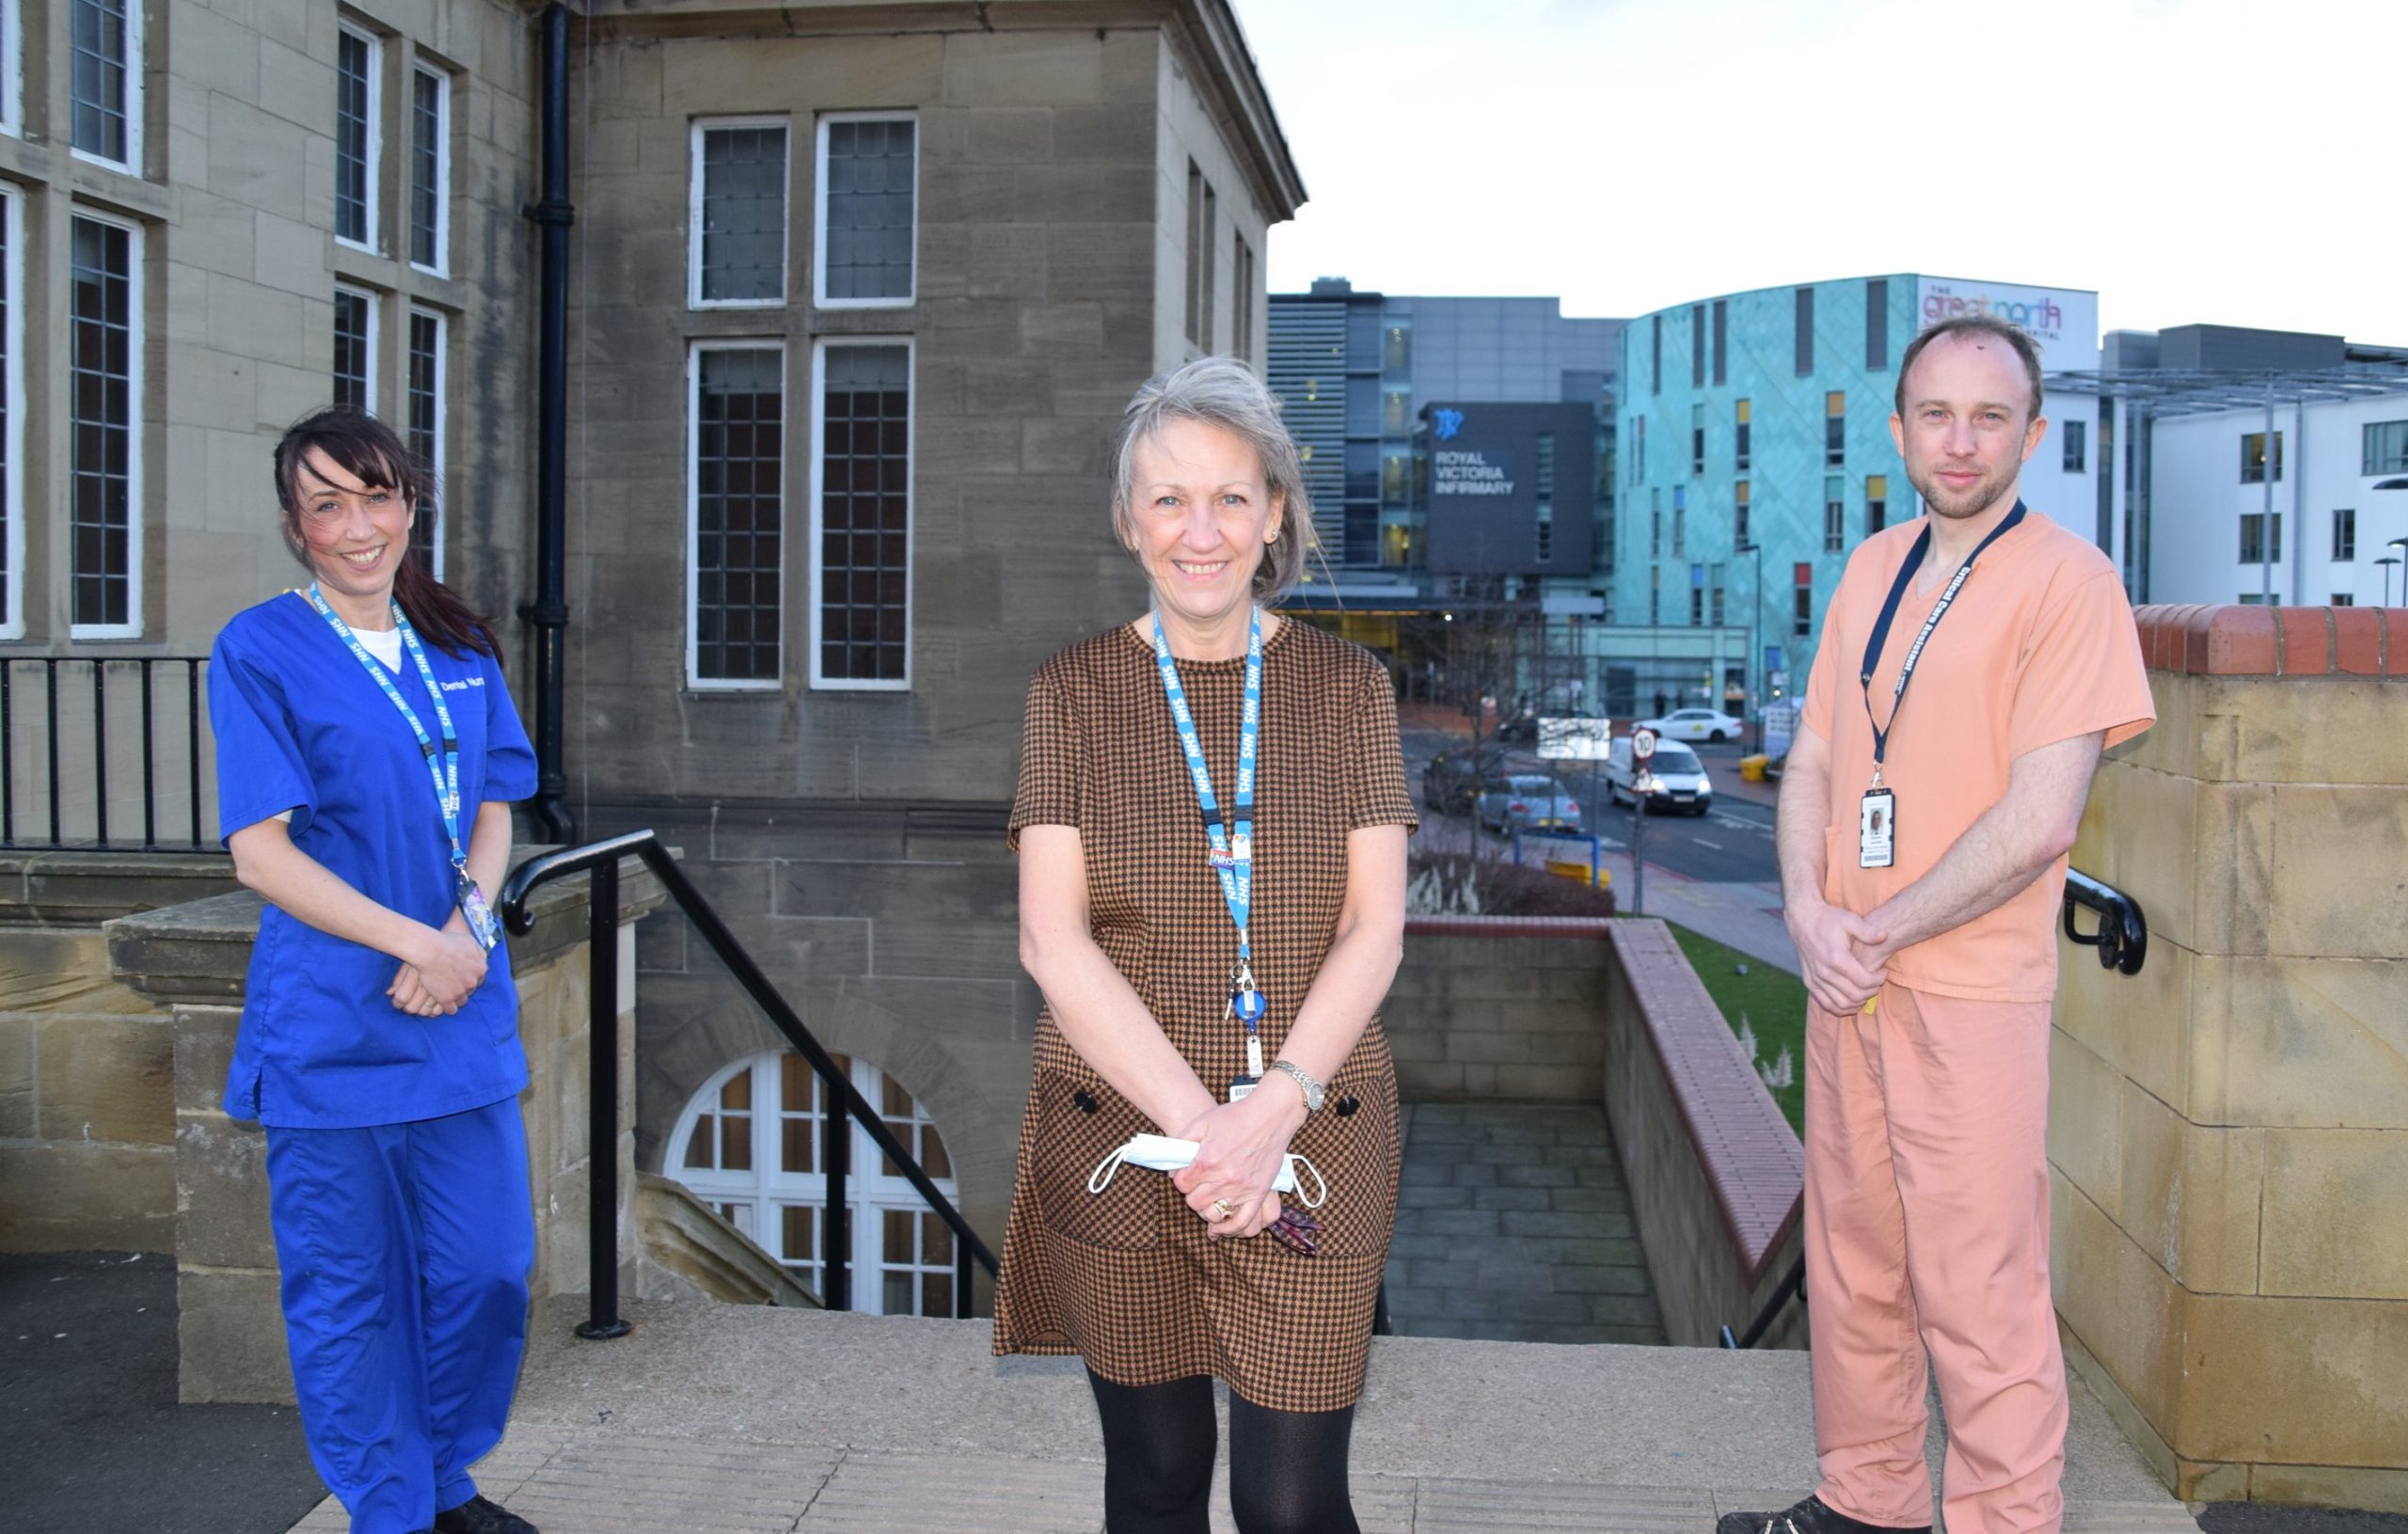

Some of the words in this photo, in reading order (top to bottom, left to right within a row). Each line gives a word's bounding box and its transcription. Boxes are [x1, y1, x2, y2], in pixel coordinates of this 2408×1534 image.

[1994, 296, 2062, 330] north
[1435, 451, 1487, 467] ROYAL
[1435, 467, 1505, 480] VICTORIA
[1435, 481, 1514, 495] INFIRMARY
[314, 595, 330, 615] NHS
[331, 618, 351, 638] NHS
[351, 642, 370, 662] NHS
[1156, 635, 1168, 658] NHS
[1250, 632, 1260, 658] NHS
[370, 667, 389, 687] NHS
[391, 605, 405, 624] NHS
[402, 629, 419, 649] NHS
[414, 654, 431, 674] NHS
[426, 680, 442, 699] NHS
[436, 706, 452, 727] NHS
[1163, 665, 1179, 690] NHS
[1247, 664, 1259, 690] NHS
[441, 682, 468, 691] Dental
[388, 691, 407, 711] NHS
[1173, 698, 1190, 723] NHS
[1244, 698, 1257, 725] NHS
[1182, 733, 1200, 758] NHS
[1242, 733, 1255, 760] NHS
[1638, 736, 1652, 751] 10
[432, 767, 445, 790] NHS
[448, 765, 457, 788] NHS
[1194, 767, 1211, 793] NHS
[1239, 767, 1252, 793] NHS
[1213, 854, 1235, 865] NHS
[1223, 873, 1238, 900] NHS
[1238, 877, 1249, 907] NHS
